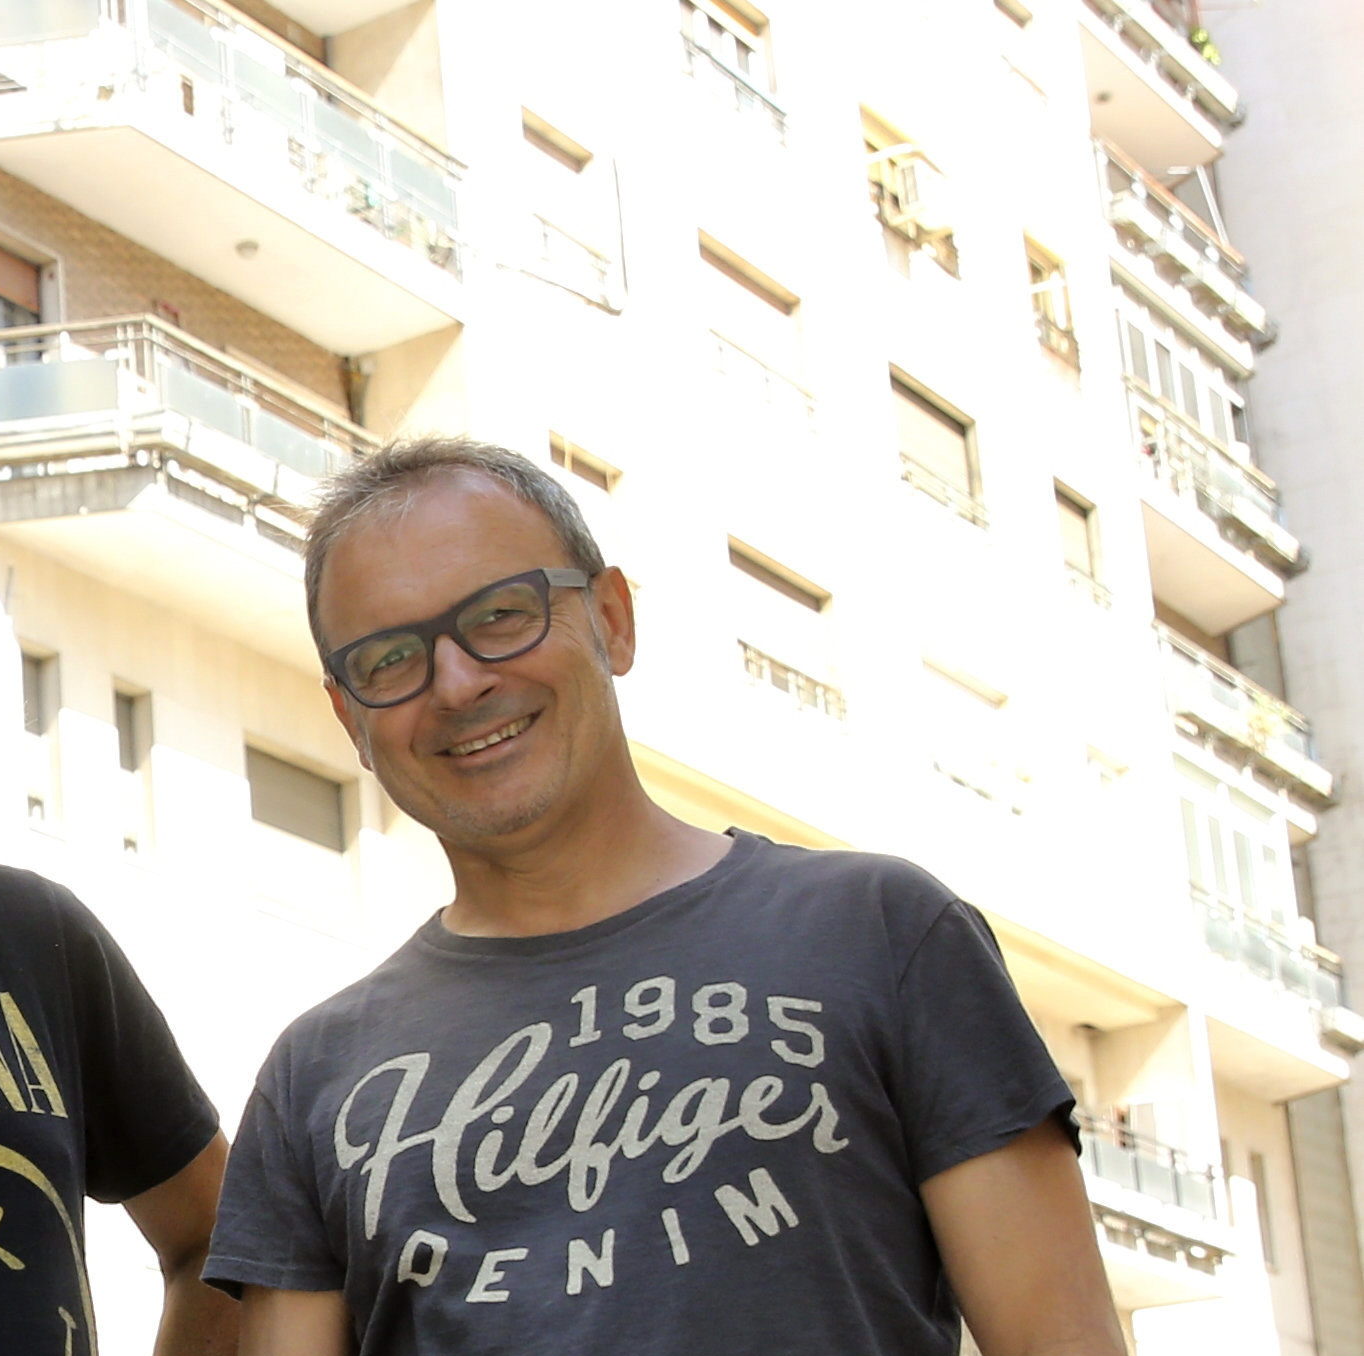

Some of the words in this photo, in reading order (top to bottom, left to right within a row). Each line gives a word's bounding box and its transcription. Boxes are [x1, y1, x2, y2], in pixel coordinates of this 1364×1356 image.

[569, 976, 825, 1068] 1985
[333, 1022, 849, 1240] Hilfiger
[397, 1167, 800, 1303] DENIM
